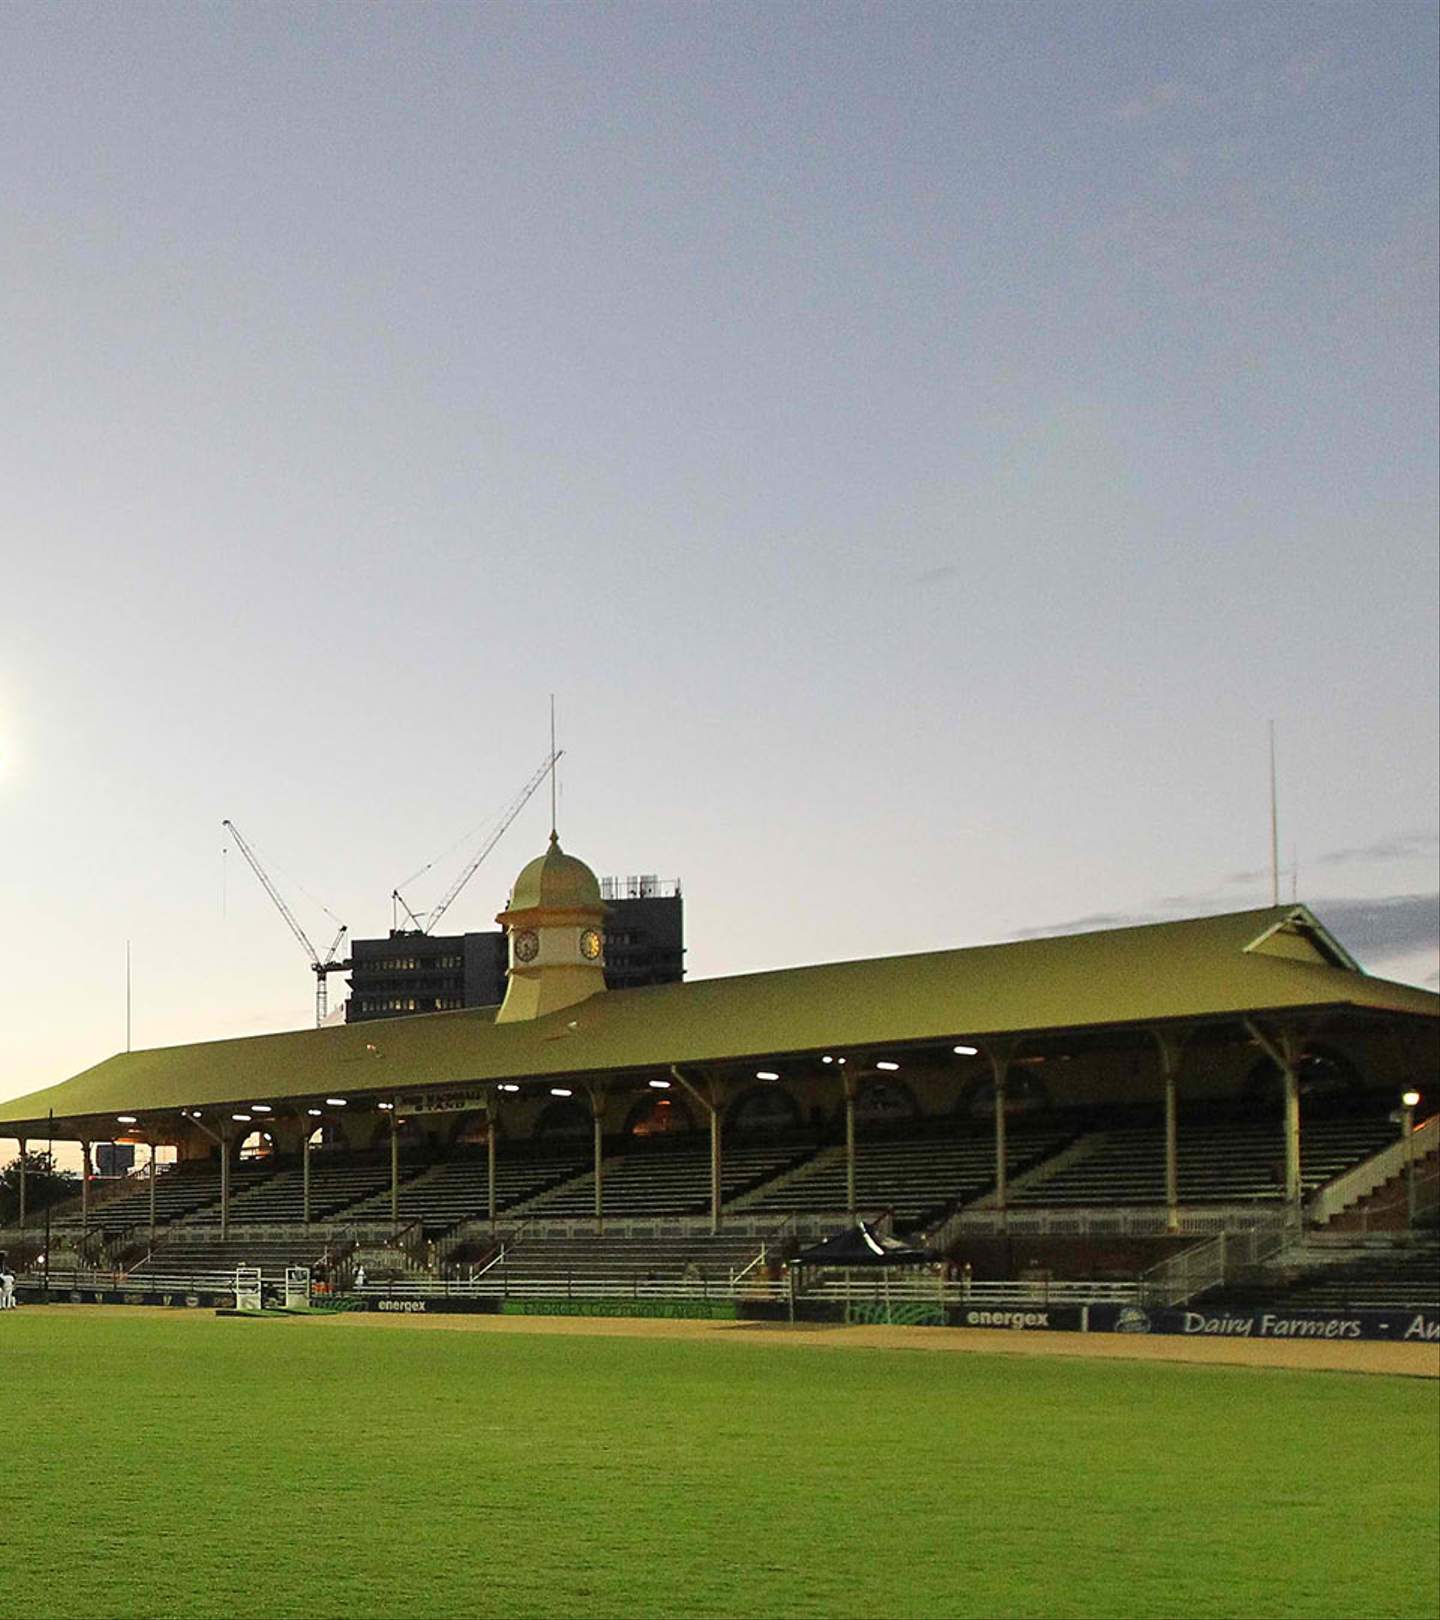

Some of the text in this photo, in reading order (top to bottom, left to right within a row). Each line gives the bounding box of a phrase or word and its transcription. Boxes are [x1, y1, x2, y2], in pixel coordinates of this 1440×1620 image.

[378, 1300, 426, 1311] energex
[967, 1310, 1049, 1329] energex
[1184, 1312, 1253, 1337] Dairy
[1260, 1314, 1361, 1337] Farmers
